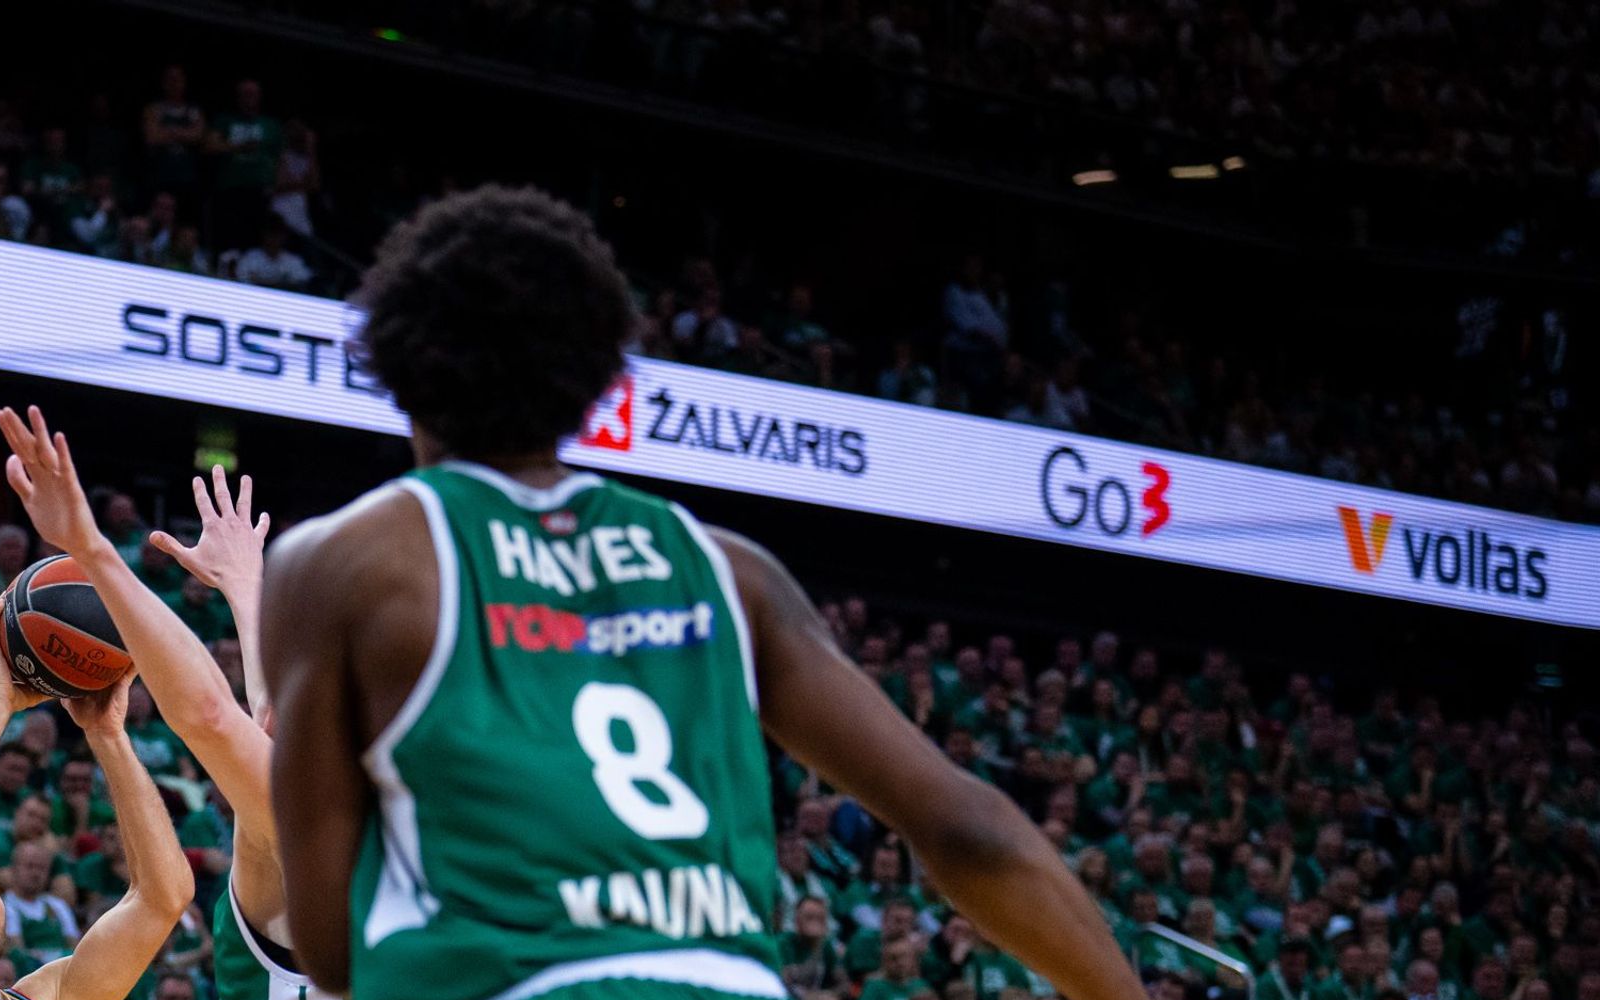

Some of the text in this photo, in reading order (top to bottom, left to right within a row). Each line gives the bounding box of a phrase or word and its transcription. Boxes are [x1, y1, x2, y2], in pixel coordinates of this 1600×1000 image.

[647, 387, 869, 475] ŽALVARIS
[1040, 446, 1172, 540] Go3
[487, 519, 672, 597] HAYES
[1403, 528, 1550, 601] voltas
[485, 601, 713, 656] TOPsport
[571, 681, 710, 840] 8
